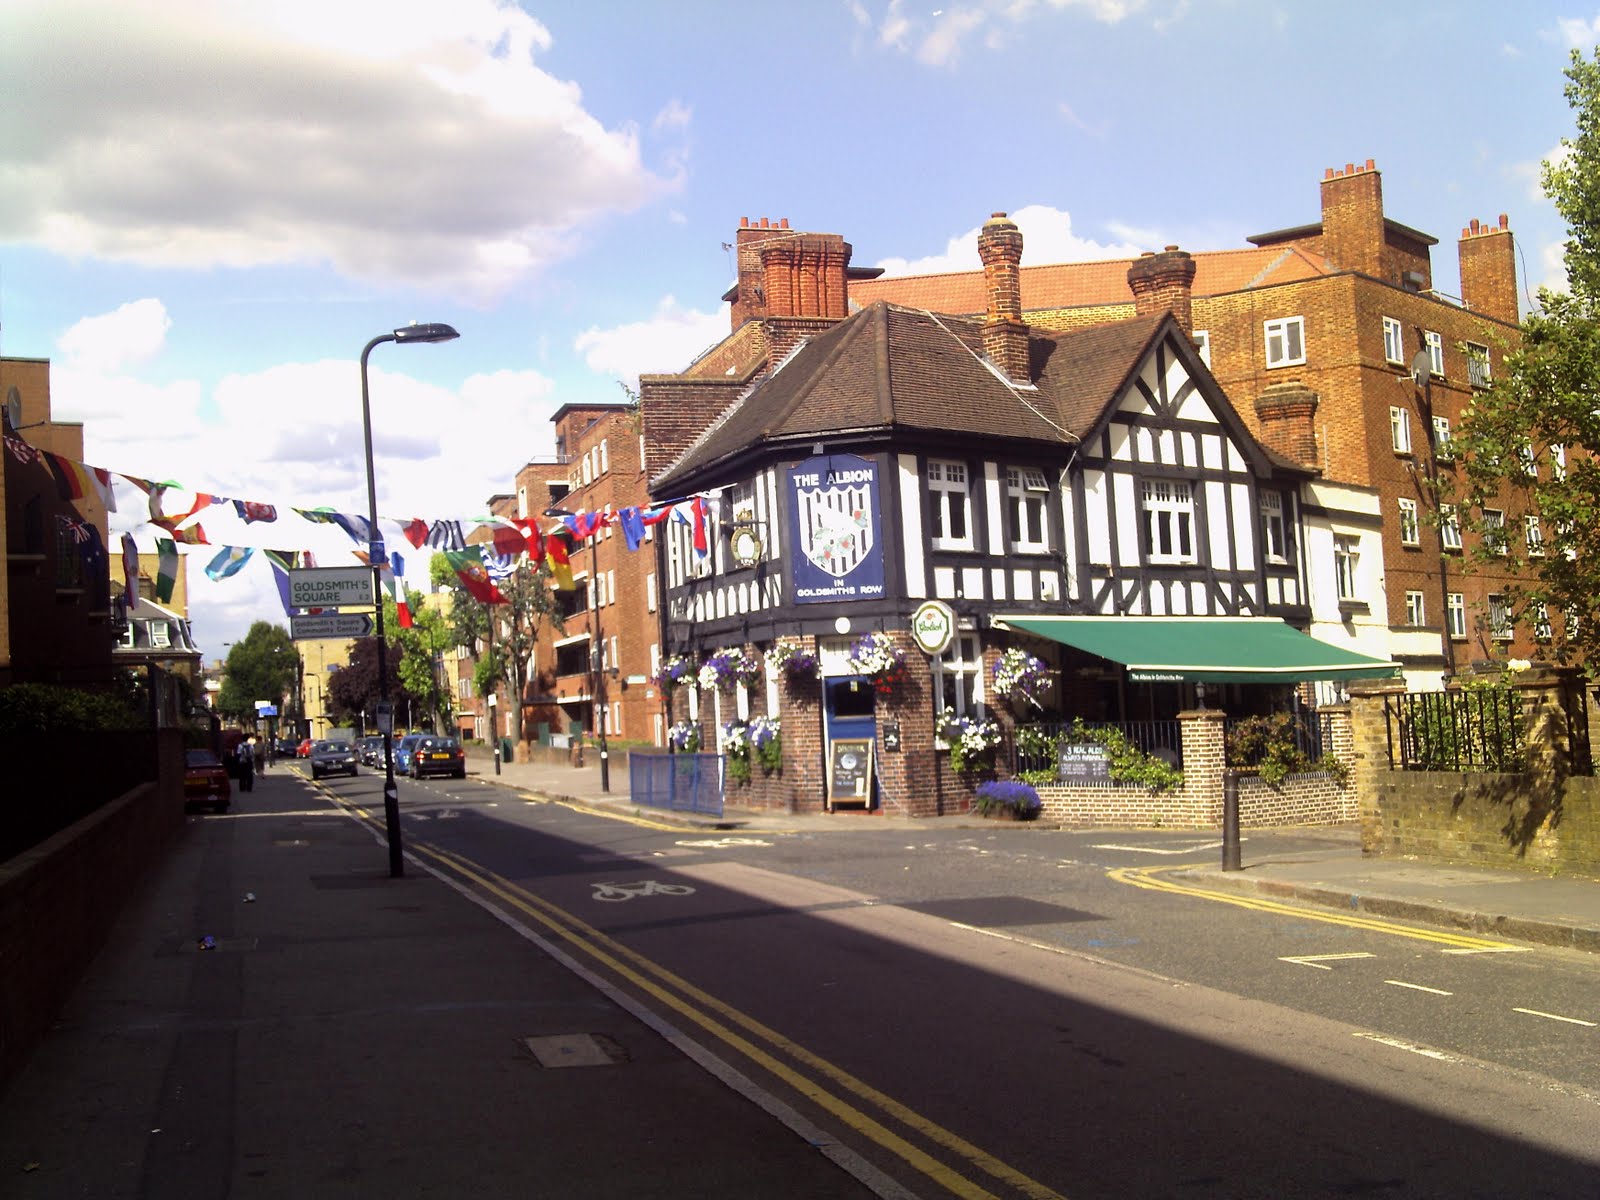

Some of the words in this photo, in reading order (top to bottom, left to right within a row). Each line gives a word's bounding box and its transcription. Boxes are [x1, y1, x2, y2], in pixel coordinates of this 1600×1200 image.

[793, 474, 819, 487] THE
[827, 469, 873, 485] ALBION
[294, 580, 369, 591] GOLDSMITH'S
[797, 587, 855, 597] GOLDSMITHS
[860, 585, 882, 594] ROW
[294, 592, 340, 602] SQUARE
